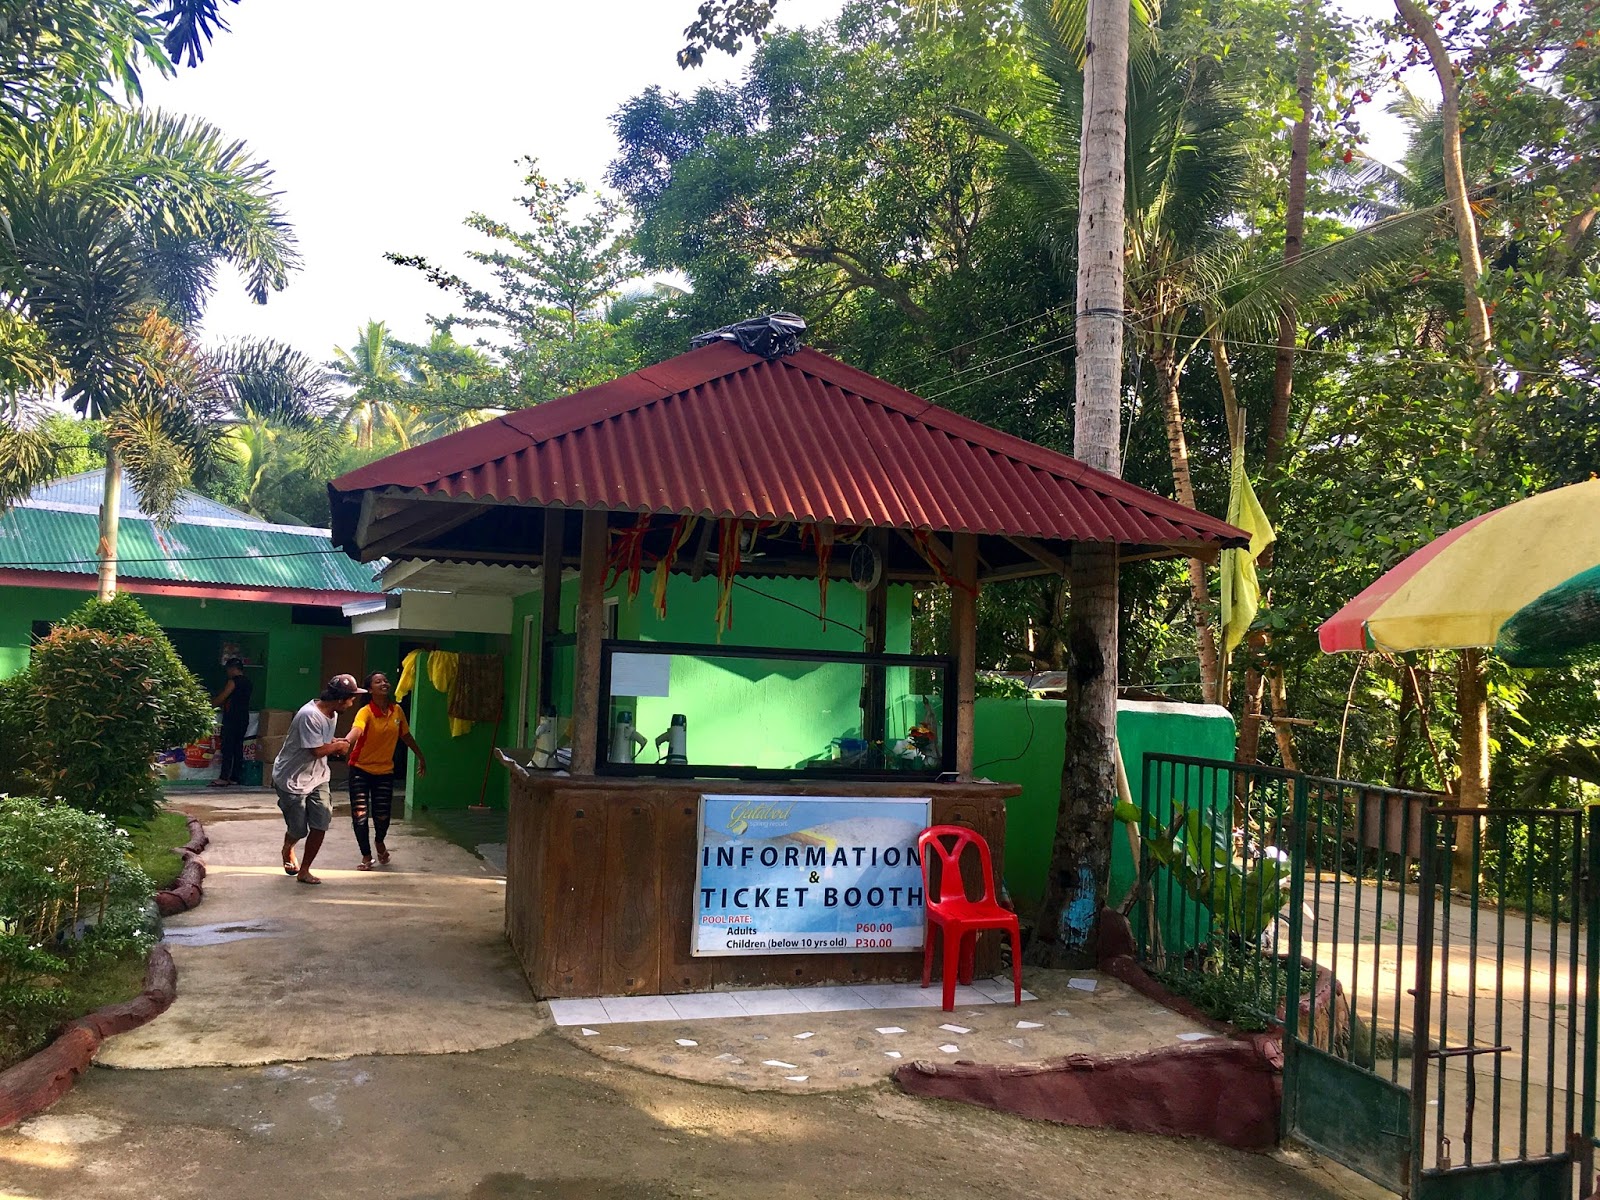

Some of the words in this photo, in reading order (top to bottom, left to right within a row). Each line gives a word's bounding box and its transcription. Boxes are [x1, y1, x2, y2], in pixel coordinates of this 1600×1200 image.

[703, 846, 922, 867] INFORMATION
[809, 871, 820, 884] &
[701, 887, 809, 908] TICKET
[824, 887, 923, 907] BOOTH
[702, 916, 726, 924] POOL
[727, 927, 757, 936] Adults
[856, 923, 893, 933] P60.00
[726, 939, 766, 949] Children
[768, 938, 799, 949] (below
[802, 938, 812, 947] 10
[814, 940, 828, 949] yrs
[830, 937, 848, 948] old)
[855, 938, 892, 948] P30.00
